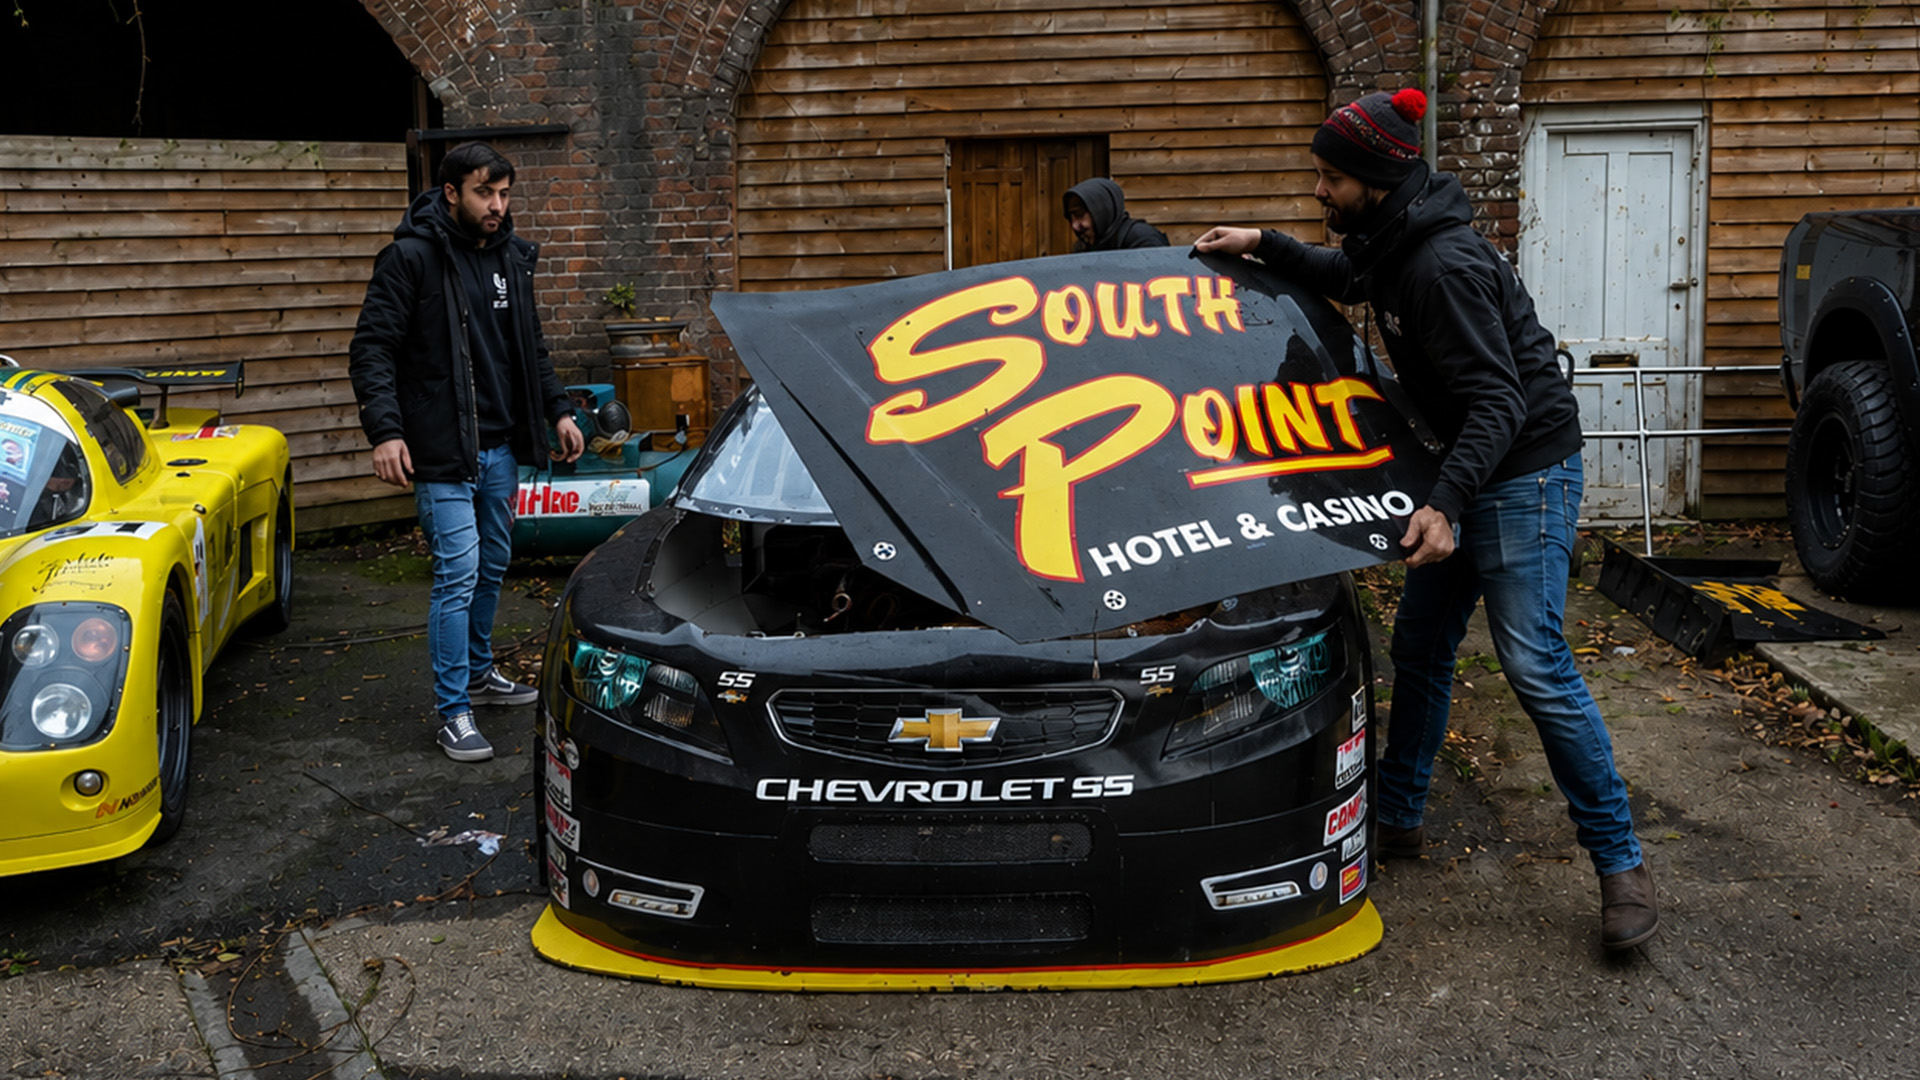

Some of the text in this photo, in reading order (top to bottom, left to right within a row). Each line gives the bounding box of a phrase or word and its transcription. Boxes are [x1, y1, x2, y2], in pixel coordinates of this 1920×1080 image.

[866, 275, 1245, 445] SOUTH
[981, 373, 1387, 582] POINT
[1088, 490, 1415, 578] HOTEL & CASINO
[717, 671, 757, 689] SS
[1140, 664, 1177, 685] SS
[756, 774, 1135, 803] CHEVROLET SS
